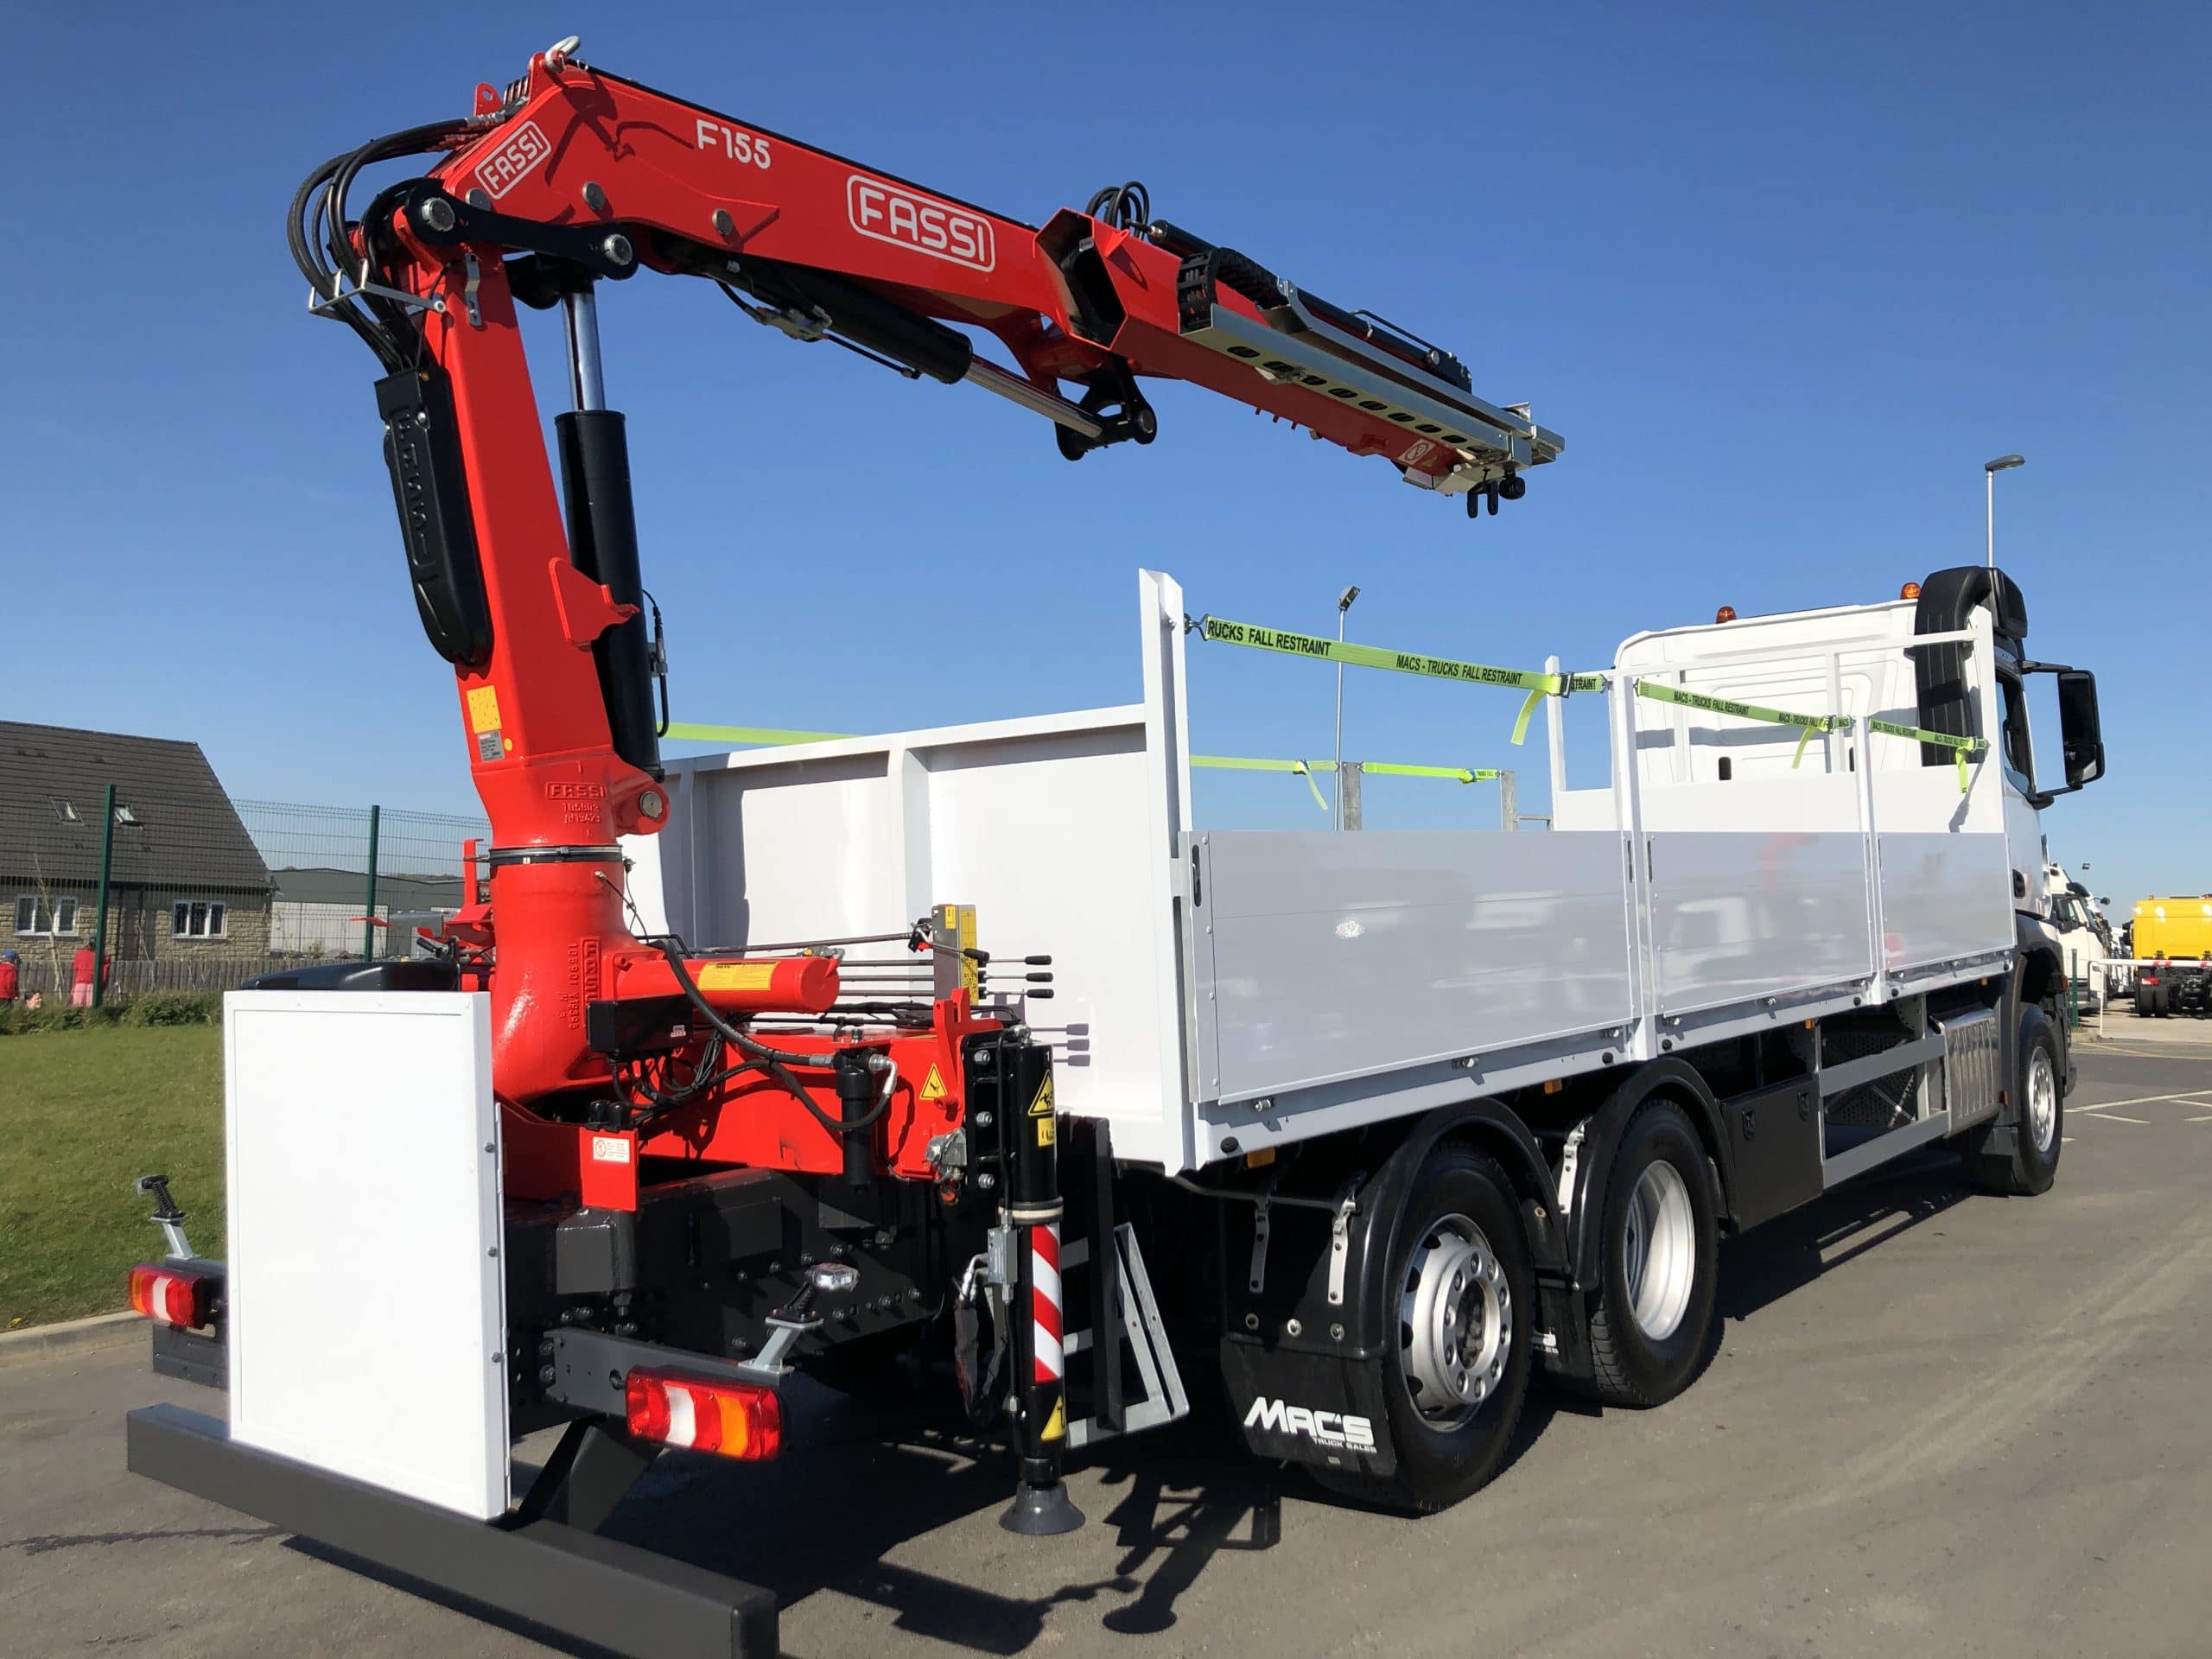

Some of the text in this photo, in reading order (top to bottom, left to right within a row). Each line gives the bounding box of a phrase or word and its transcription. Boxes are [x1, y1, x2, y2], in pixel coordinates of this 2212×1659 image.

[483, 130, 543, 190] FASSI
[696, 118, 771, 169] F155
[859, 187, 985, 262] FASSI
[1207, 620, 1332, 656] RUCKS FALL RESTRAINT
[1396, 654, 1421, 671] MACS
[1427, 659, 1459, 677] TRUCKS
[1462, 664, 1480, 680] FALL
[1481, 670, 1522, 685] RESTRAINT
[1674, 690, 1688, 703] MACS
[550, 784, 604, 798] FASSI
